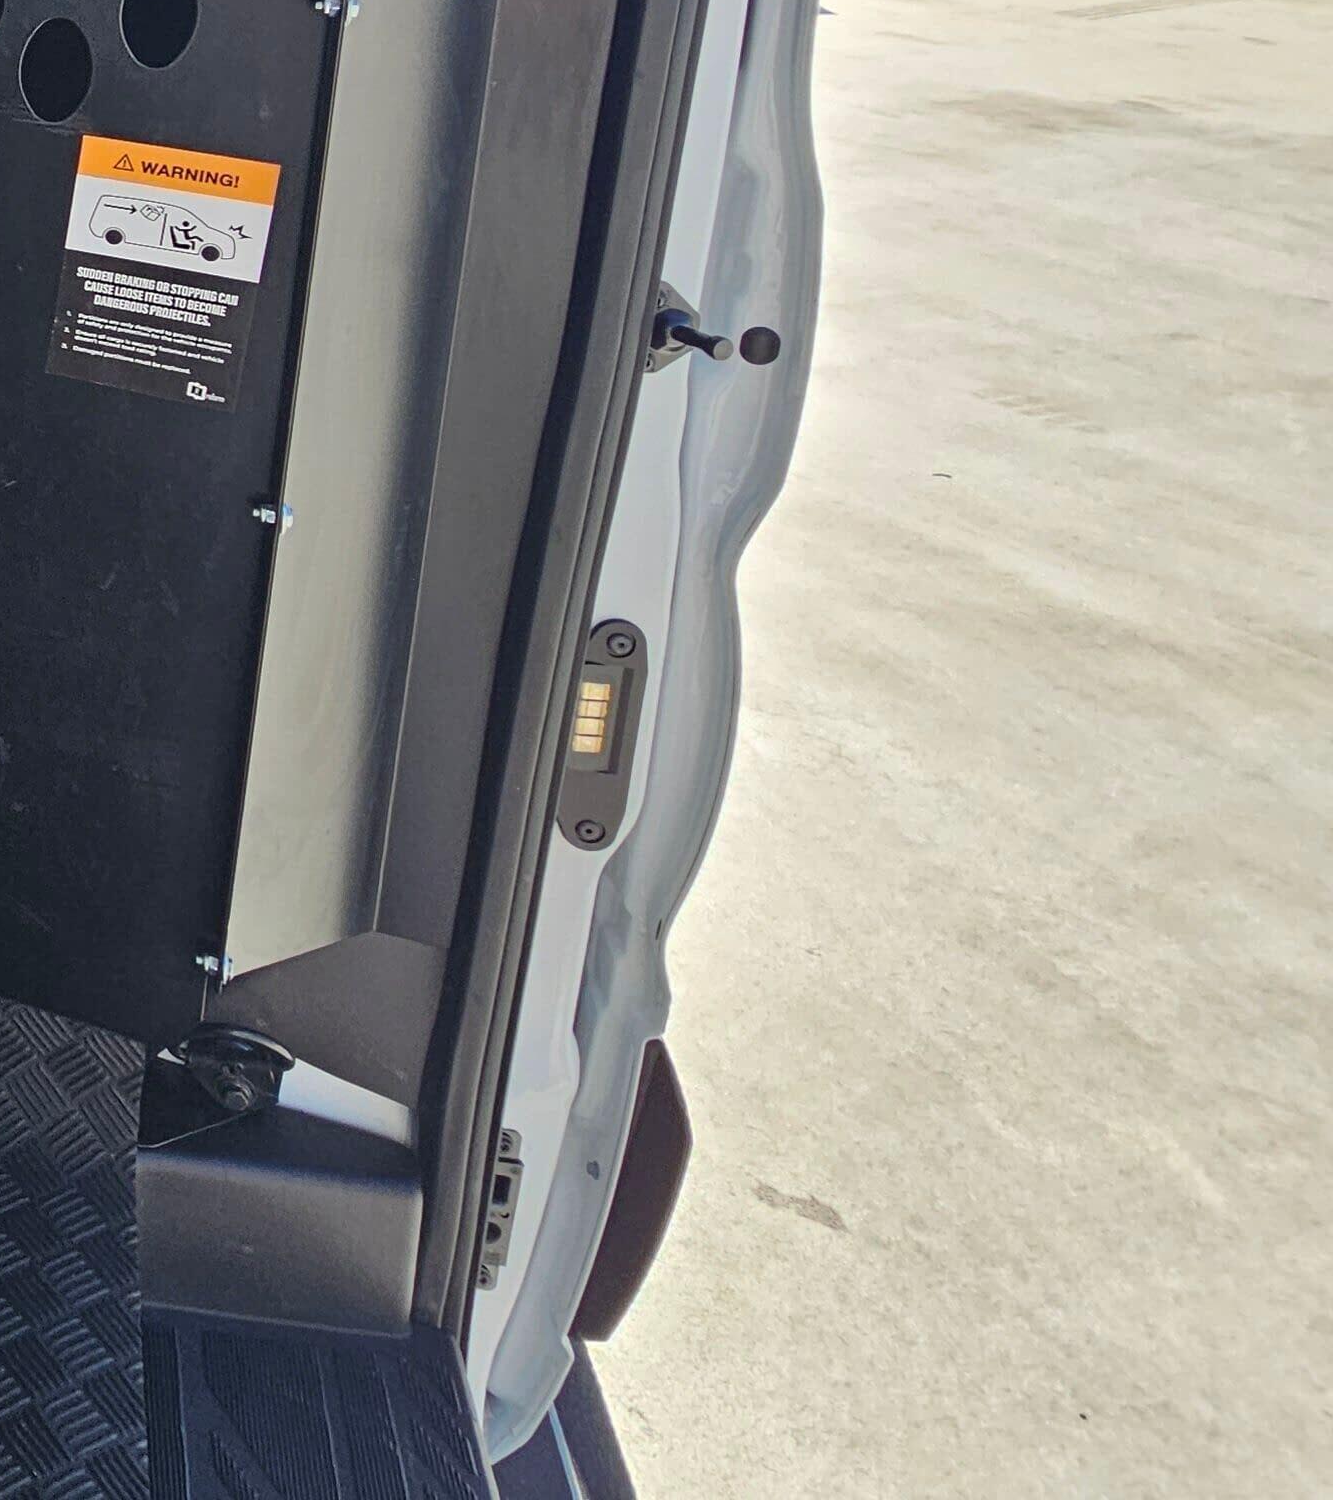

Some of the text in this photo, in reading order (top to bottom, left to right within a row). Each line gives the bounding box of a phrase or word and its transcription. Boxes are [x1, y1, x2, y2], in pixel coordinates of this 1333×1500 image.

[141, 160, 240, 188] WARNING!
[76, 266, 114, 282] SUDDEN
[114, 273, 156, 290] BRAKING
[156, 281, 170, 293] OR
[170, 283, 218, 302] STOPPING
[84, 280, 227, 317] CAUSE LOOSE ITEMS TO BECOME
[93, 294, 211, 327] DANGEROUS PROJECTILES.
